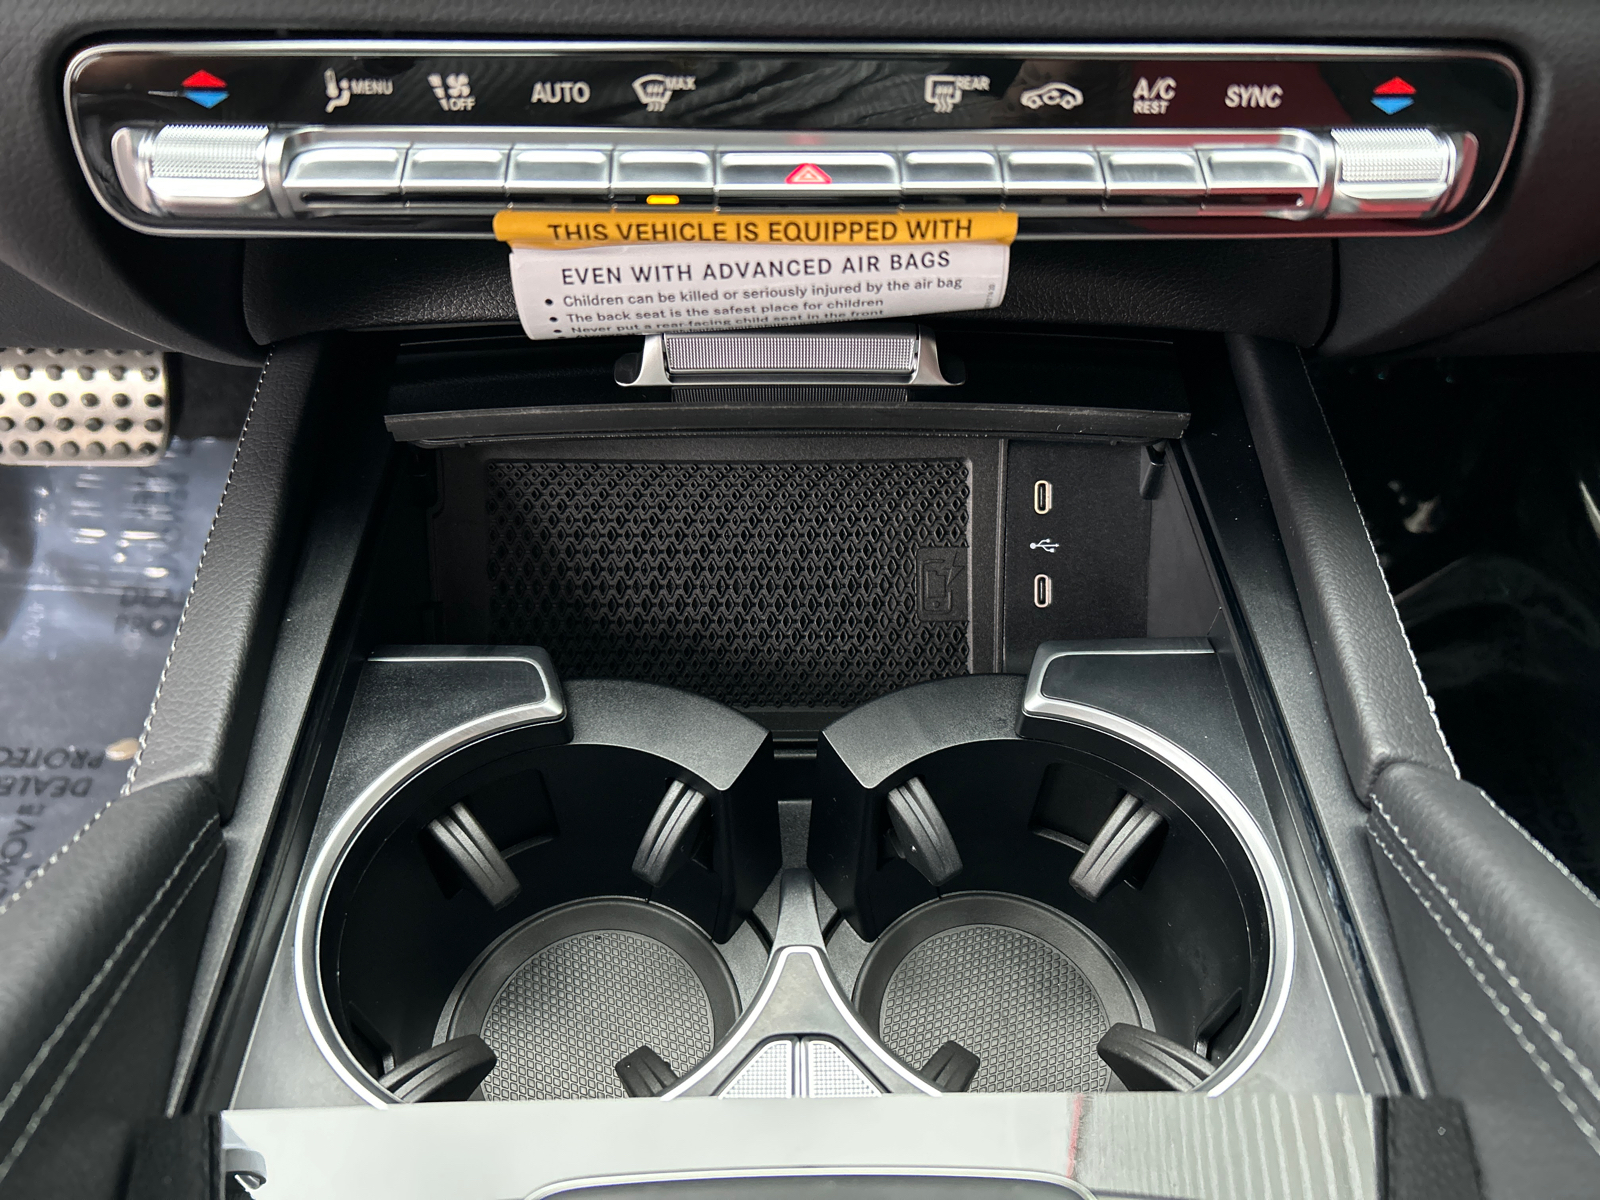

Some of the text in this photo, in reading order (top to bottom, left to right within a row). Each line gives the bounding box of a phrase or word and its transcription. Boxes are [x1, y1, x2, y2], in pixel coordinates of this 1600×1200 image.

[351, 79, 394, 96] MENU
[530, 81, 591, 104] AUTO
[664, 75, 697, 91] MAX
[956, 75, 991, 92] REAR
[1132, 75, 1177, 99] A/C
[449, 97, 476, 111] OFF
[1133, 99, 1170, 115] REST
[1224, 83, 1284, 109] SYNC
[548, 218, 973, 243] THIS VEHICLE IS EQUIPPED WITH
[561, 250, 951, 285] EVEN WITH ADVANCED AIR BAGS
[563, 276, 963, 308] Children can be killed or seriously injured by the air bag
[567, 298, 884, 324] The back seat is the safest place for children
[571, 326, 606, 336] Never
[616, 323, 639, 334] put
[735, 315, 769, 326] child
[773, 314, 802, 324] seat
[807, 313, 819, 321] in
[824, 311, 846, 320] the
[850, 308, 884, 319] front
